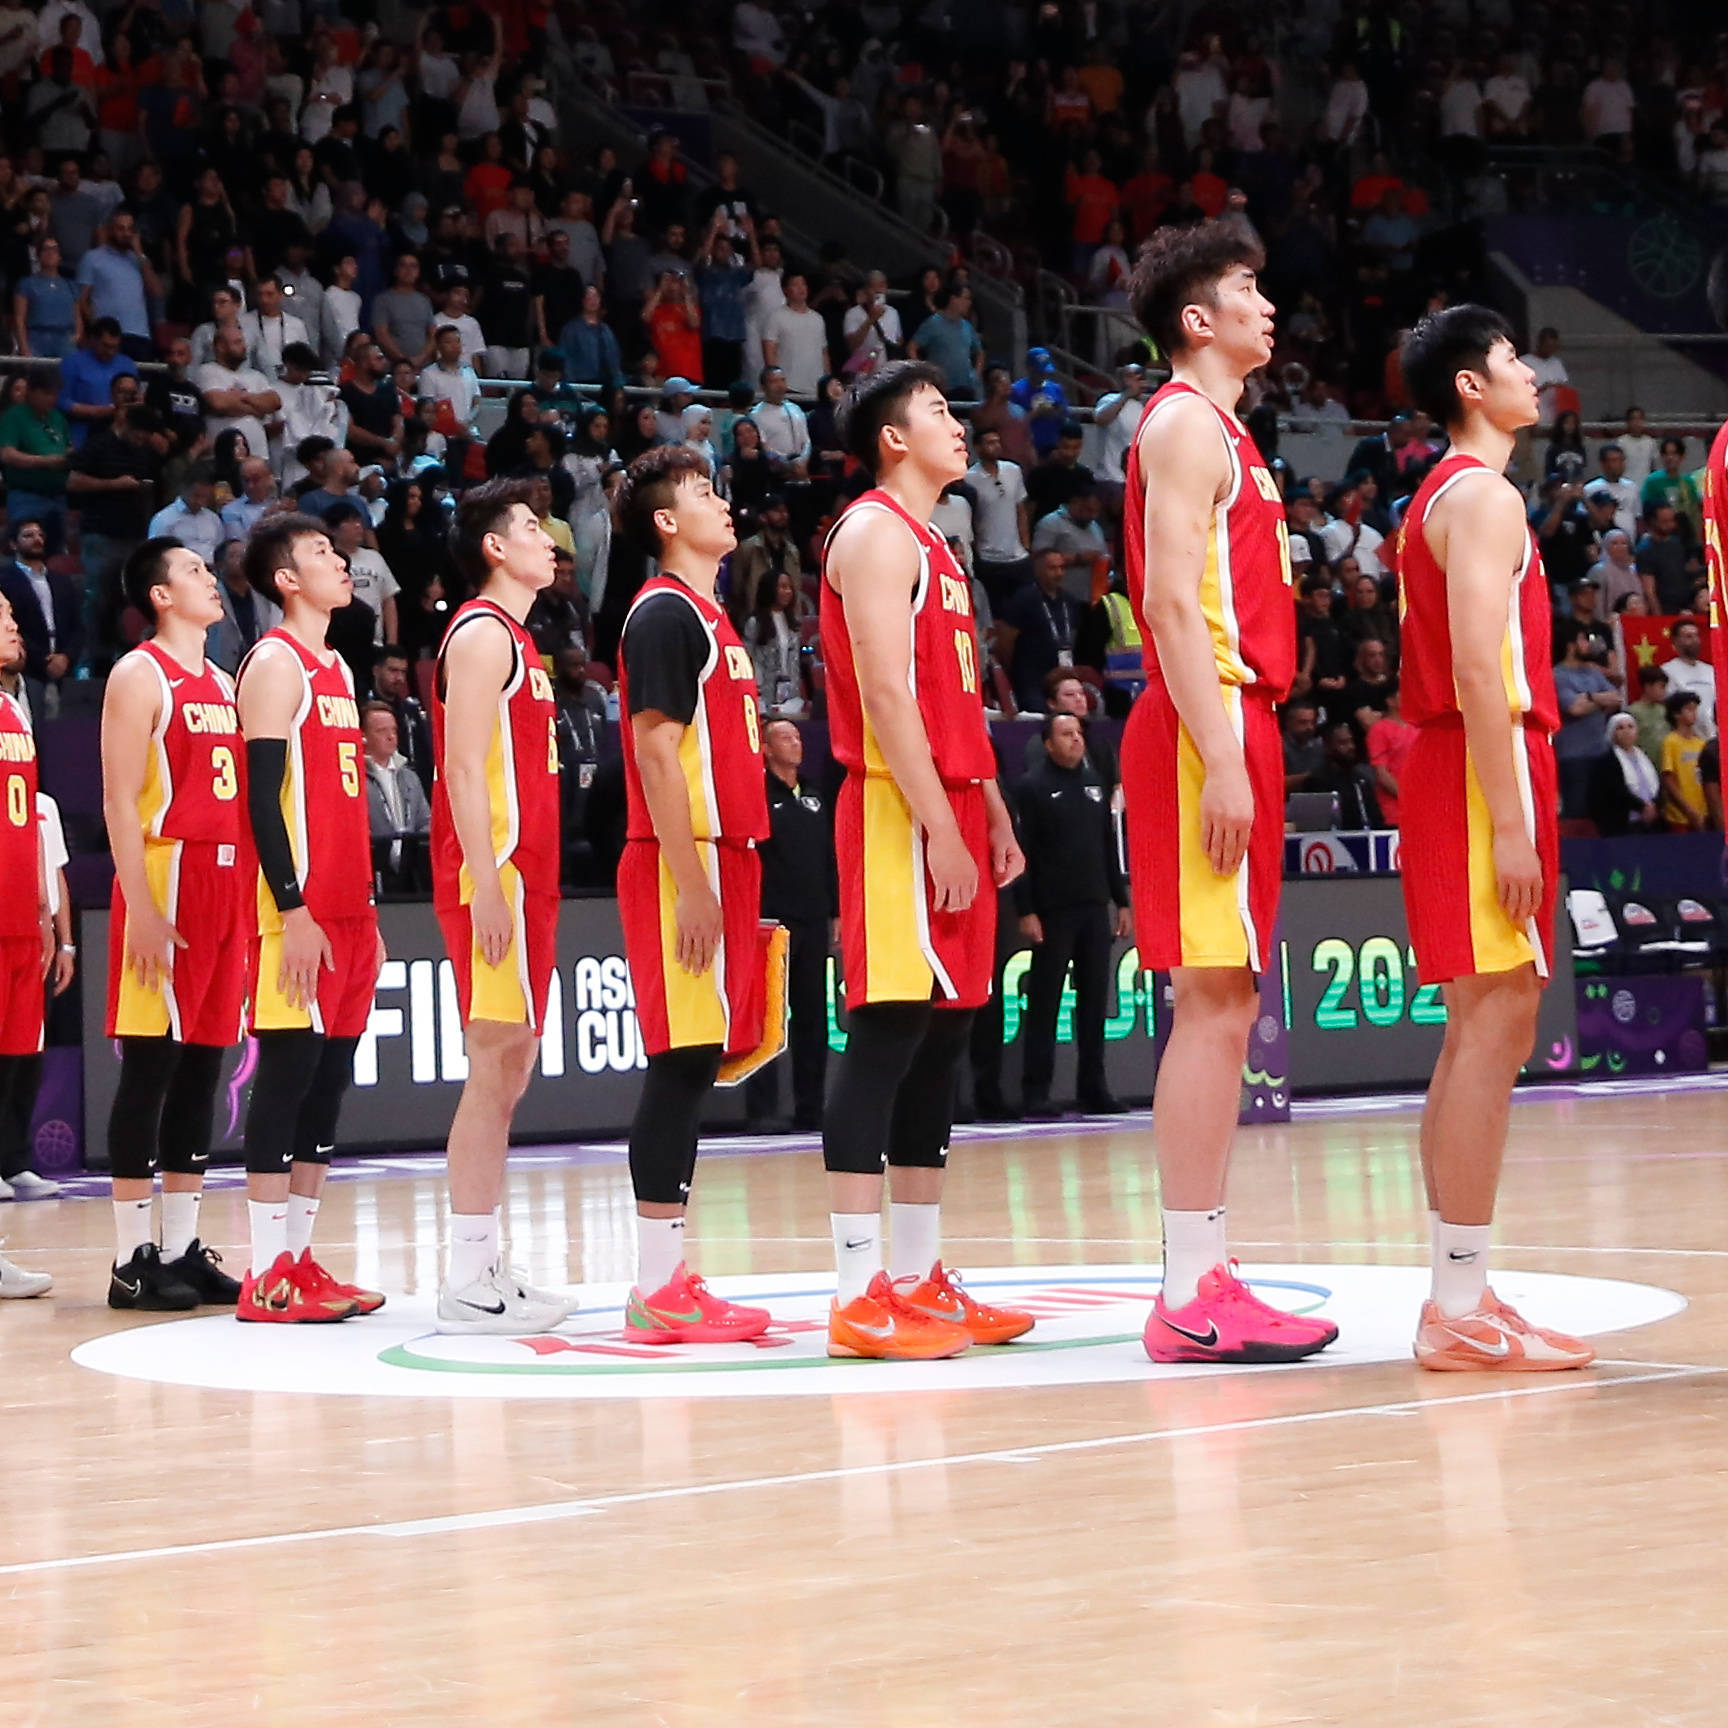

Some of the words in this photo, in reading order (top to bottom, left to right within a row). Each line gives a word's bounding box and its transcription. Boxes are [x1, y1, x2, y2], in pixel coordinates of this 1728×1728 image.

[953, 628, 977, 695] 10
[210, 746, 239, 801] 3
[338, 742, 360, 798] 5
[6, 774, 29, 828] 0
